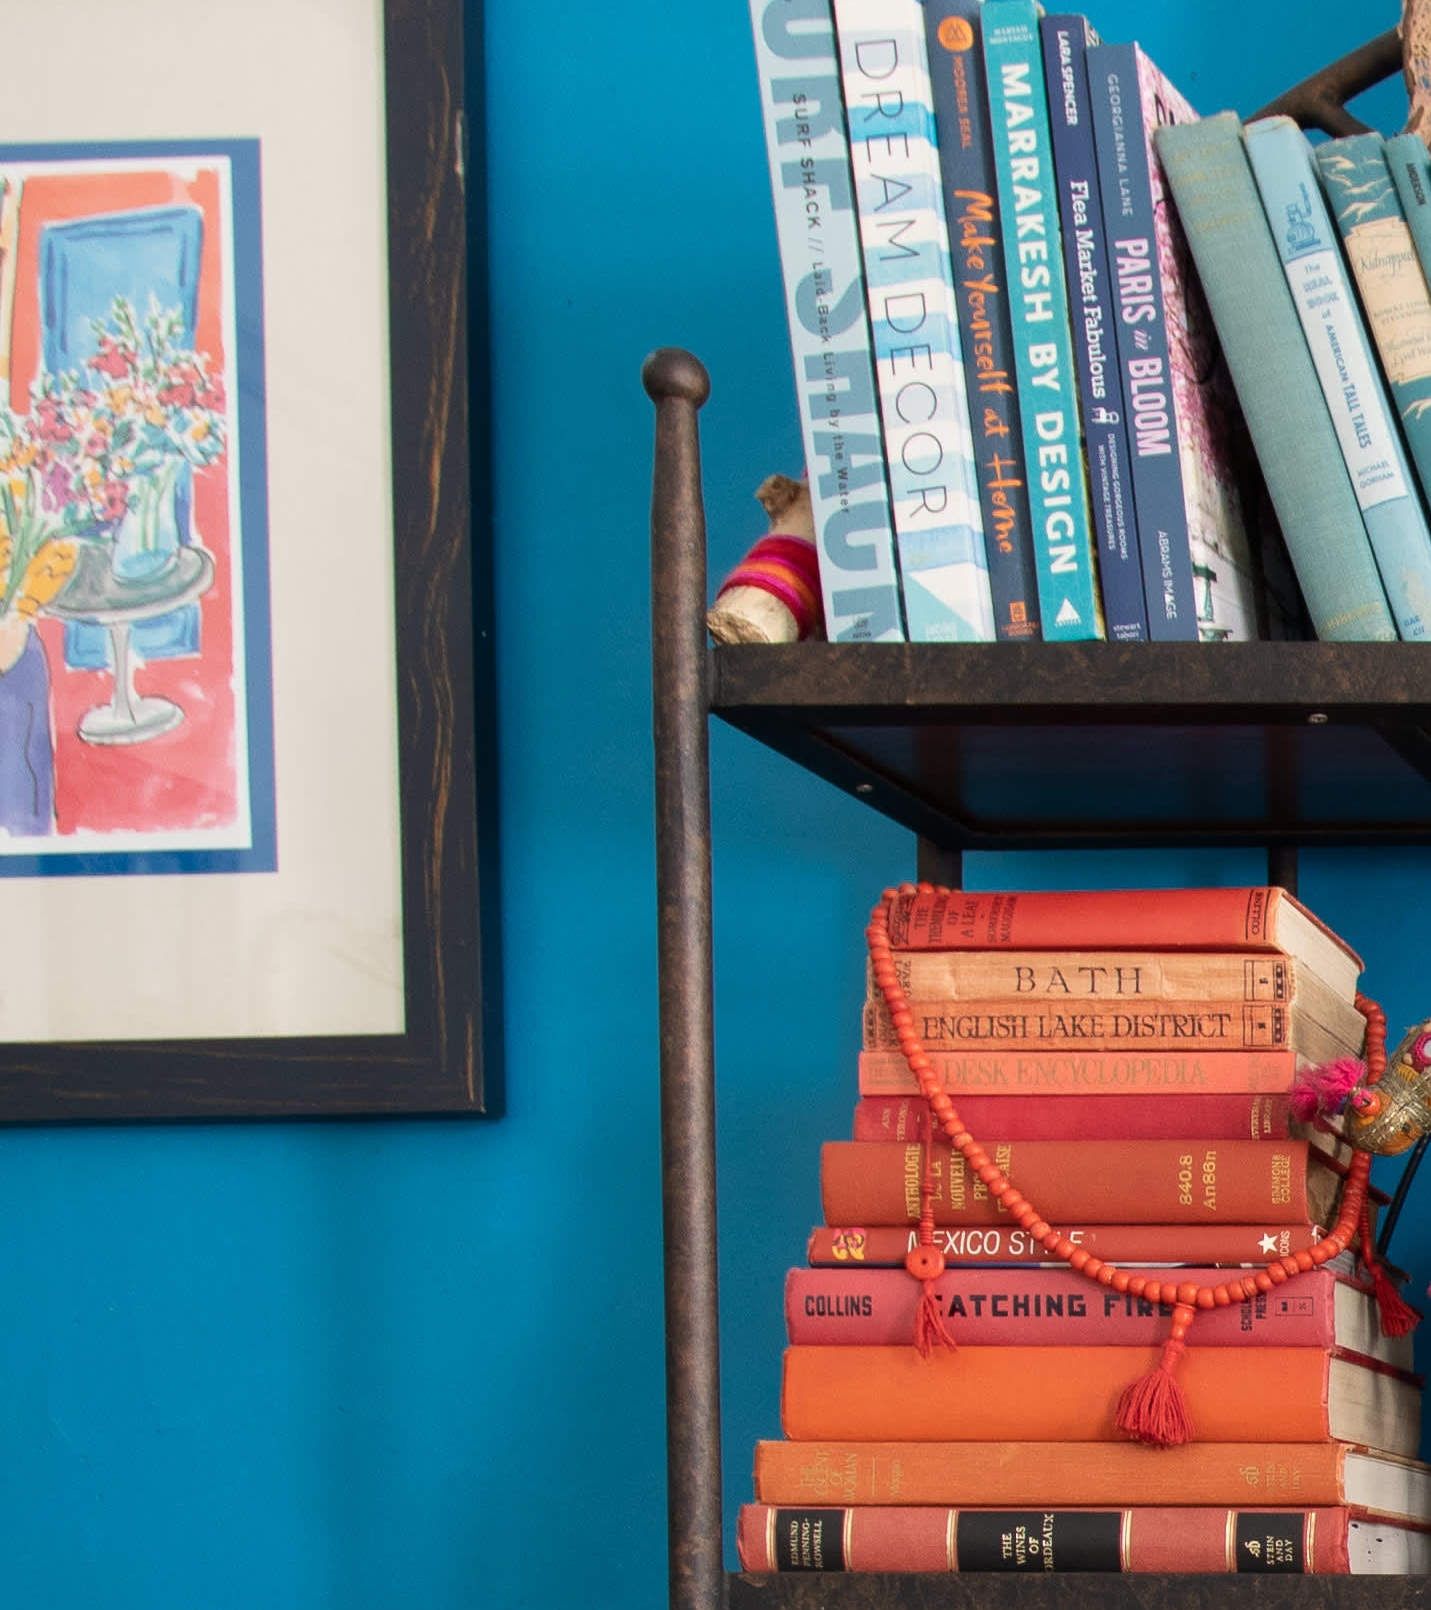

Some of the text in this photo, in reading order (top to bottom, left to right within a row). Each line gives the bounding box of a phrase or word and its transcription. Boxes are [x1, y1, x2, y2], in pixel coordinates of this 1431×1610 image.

[1056, 30, 1079, 126] LARA SPENCER
[1107, 73, 1134, 217] GEORGIANNA LANE
[855, 38, 948, 518] DREAM DECOR
[1070, 180, 1106, 399] Flea Market Fabulous
[1001, 63, 1079, 574] MARRAKESH BY DESIGN
[954, 190, 1023, 554] Make Yourself at Home
[1114, 237, 1173, 457] PARIS in BLOOM
[1015, 966, 1144, 994] BATH
[922, 1013, 1233, 1040] ENGLISH LAKE DISTRICT
[944, 1058, 1206, 1087] DESK ENCYCLOPEDIA
[1178, 1154, 1193, 1207] 840.8
[804, 1295, 873, 1317] COLLINS
[1002, 1533, 1013, 1559] THE
[1015, 1526, 1026, 1568] WINES
[1028, 1536, 1039, 1555] OF
